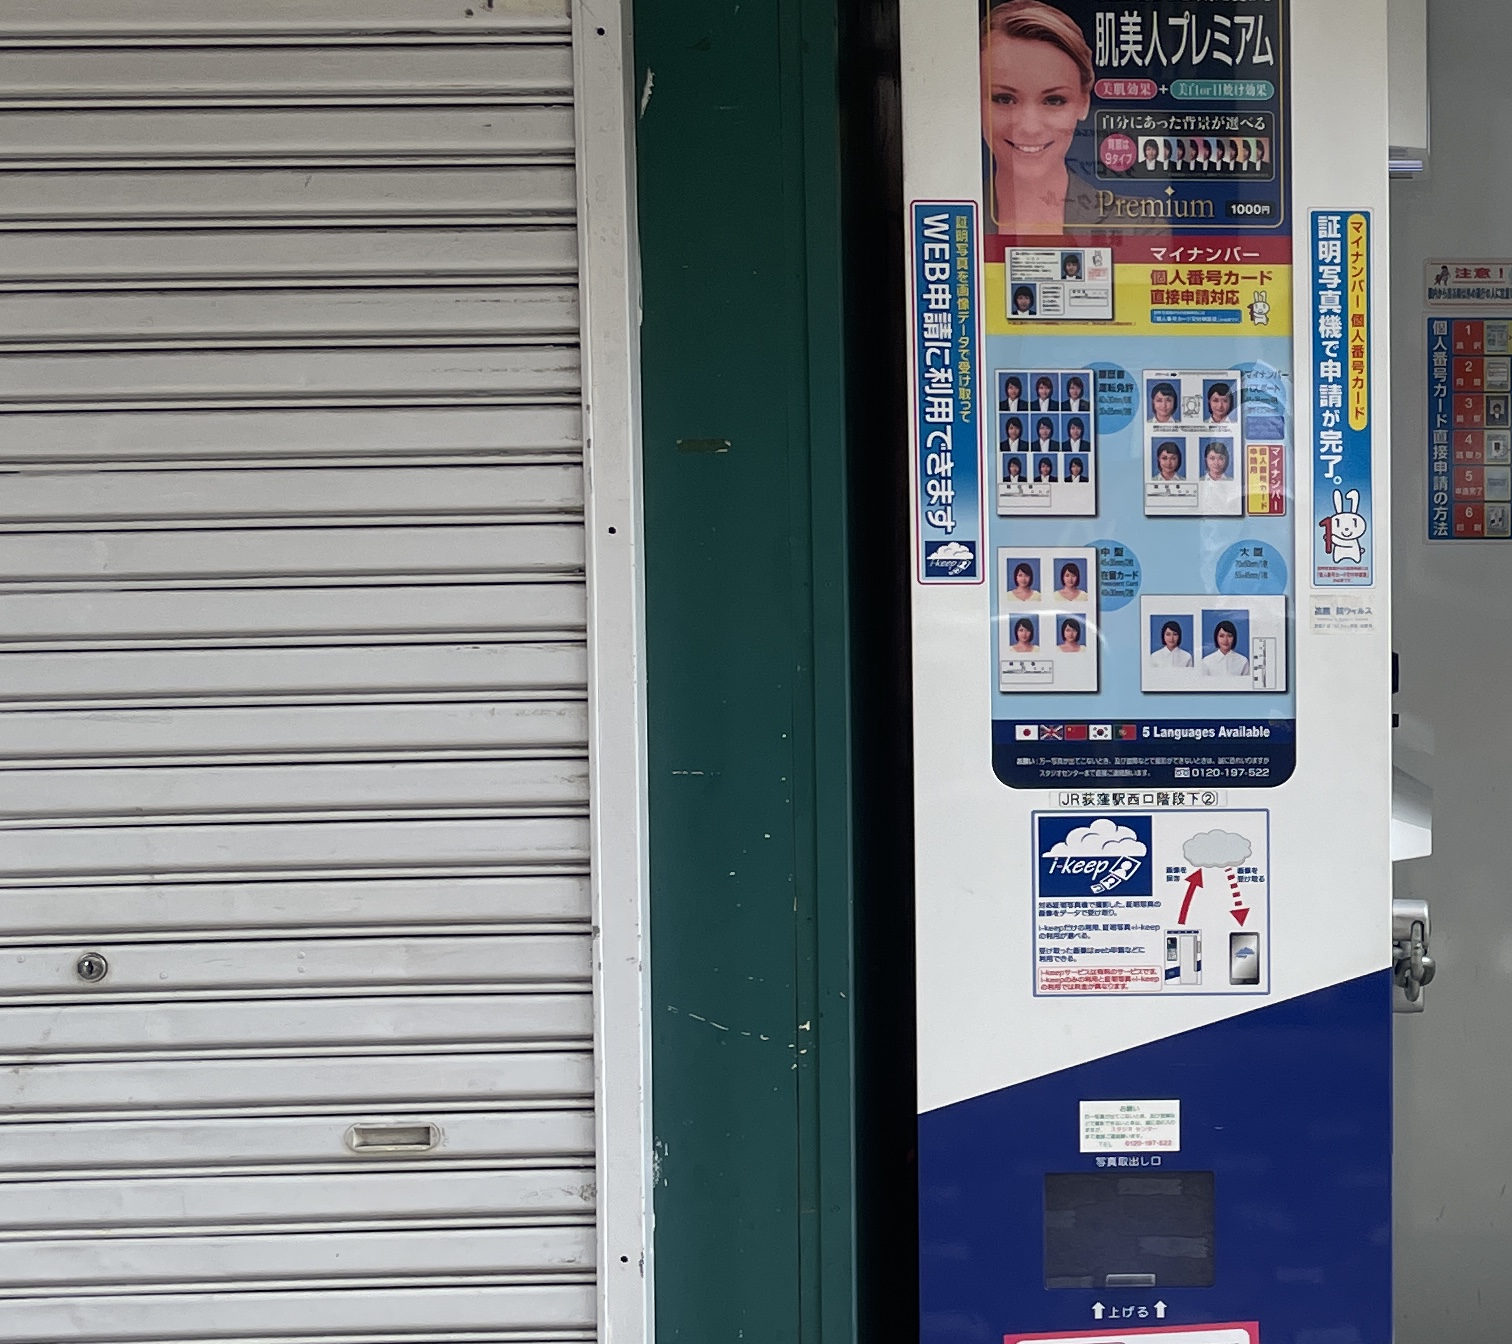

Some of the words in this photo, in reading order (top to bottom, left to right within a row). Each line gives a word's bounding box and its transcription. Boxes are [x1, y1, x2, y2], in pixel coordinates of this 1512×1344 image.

[1095, 9, 1275, 67] 肌美人プレミアム
[1102, 81, 1152, 97] 美肌効果
[1102, 114, 1267, 131] 自分にあった背景が選べる
[1097, 187, 1215, 218] Premium
[1231, 203, 1272, 216] 1000円
[1149, 246, 1260, 262] マイナンバー
[1149, 269, 1272, 287] 個人番号カード
[1149, 289, 1241, 306] 直接申請対応
[1465, 324, 1472, 336] 1
[1317, 215, 1343, 486] 証明写真機で申請が完了。
[922, 213, 958, 533] WEB申請に利用できます
[1464, 362, 1473, 373] 2
[1464, 397, 1473, 409] 3
[1432, 319, 1450, 537] 個人番号カード直接申請の方法
[1464, 434, 1473, 445] 4
[1271, 447, 1282, 511] マイナンバー
[1464, 470, 1473, 482] 5
[1464, 506, 1473, 518] 6
[1141, 725, 1150, 738] 5
[1152, 725, 1216, 740] Languages
[1217, 725, 1271, 738] Available
[1061, 791, 1217, 807] JR荻窪駅西口階段下②
[1048, 856, 1110, 881] i-keep
[1095, 1155, 1162, 1168] 写真取出し口
[1108, 1305, 1150, 1319] 上げる
